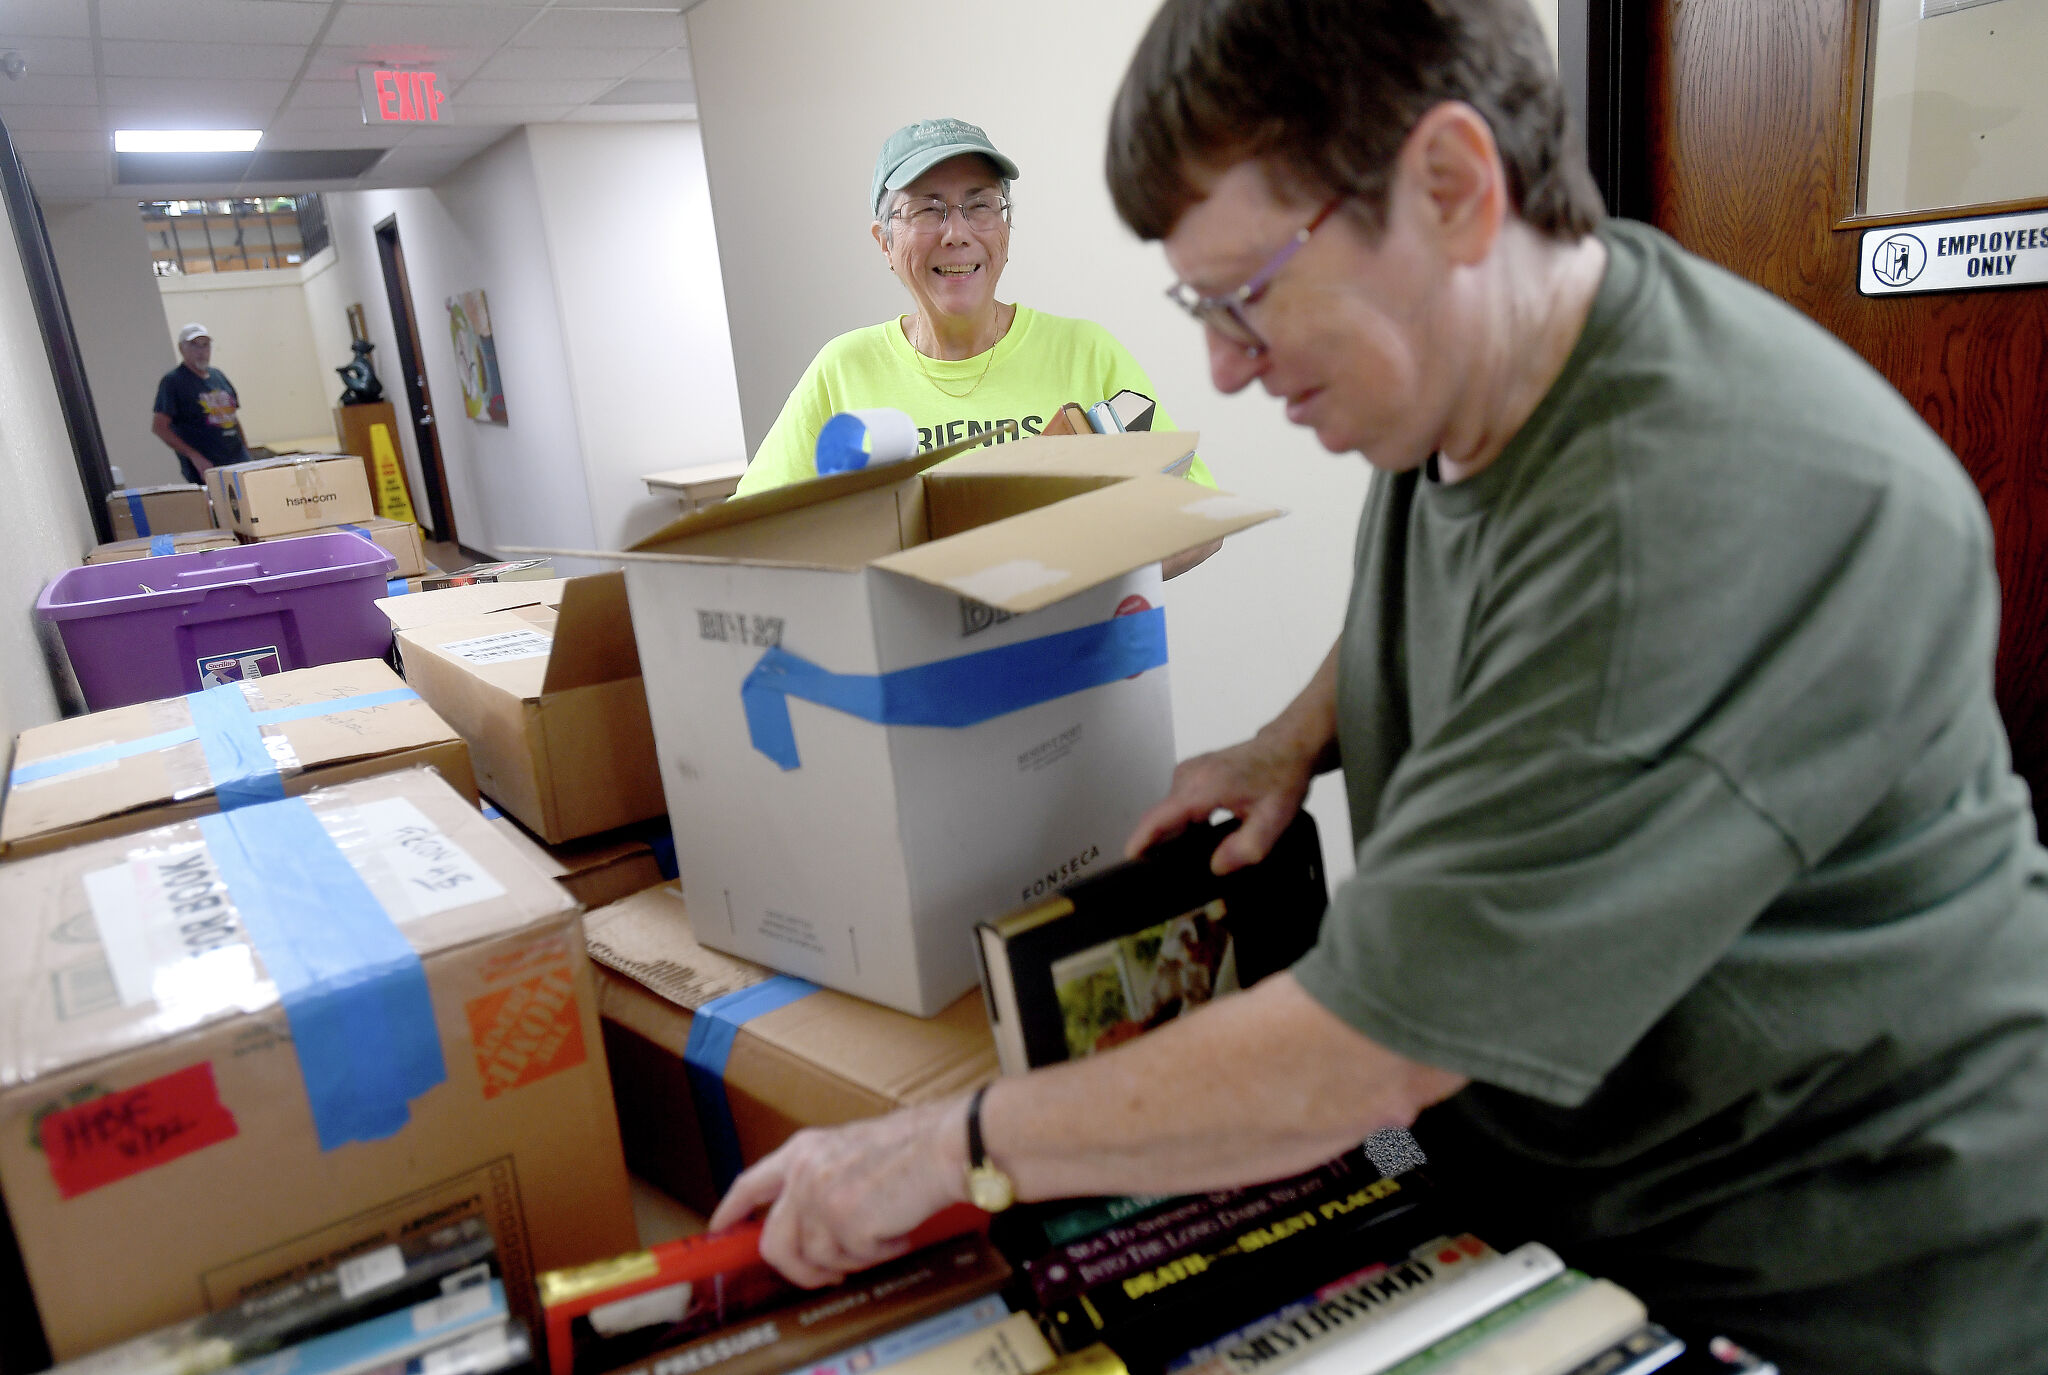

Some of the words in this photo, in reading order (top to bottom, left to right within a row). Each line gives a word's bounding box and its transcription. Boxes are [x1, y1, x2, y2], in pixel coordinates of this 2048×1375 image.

[374, 71, 438, 121] EXIT
[1937, 227, 2048, 257] EMPLOYEES
[1967, 255, 2016, 278] ONLY
[917, 415, 1043, 453] RIENDS
[158, 854, 223, 914] BOOK
[1022, 845, 1099, 901] FONSECA
